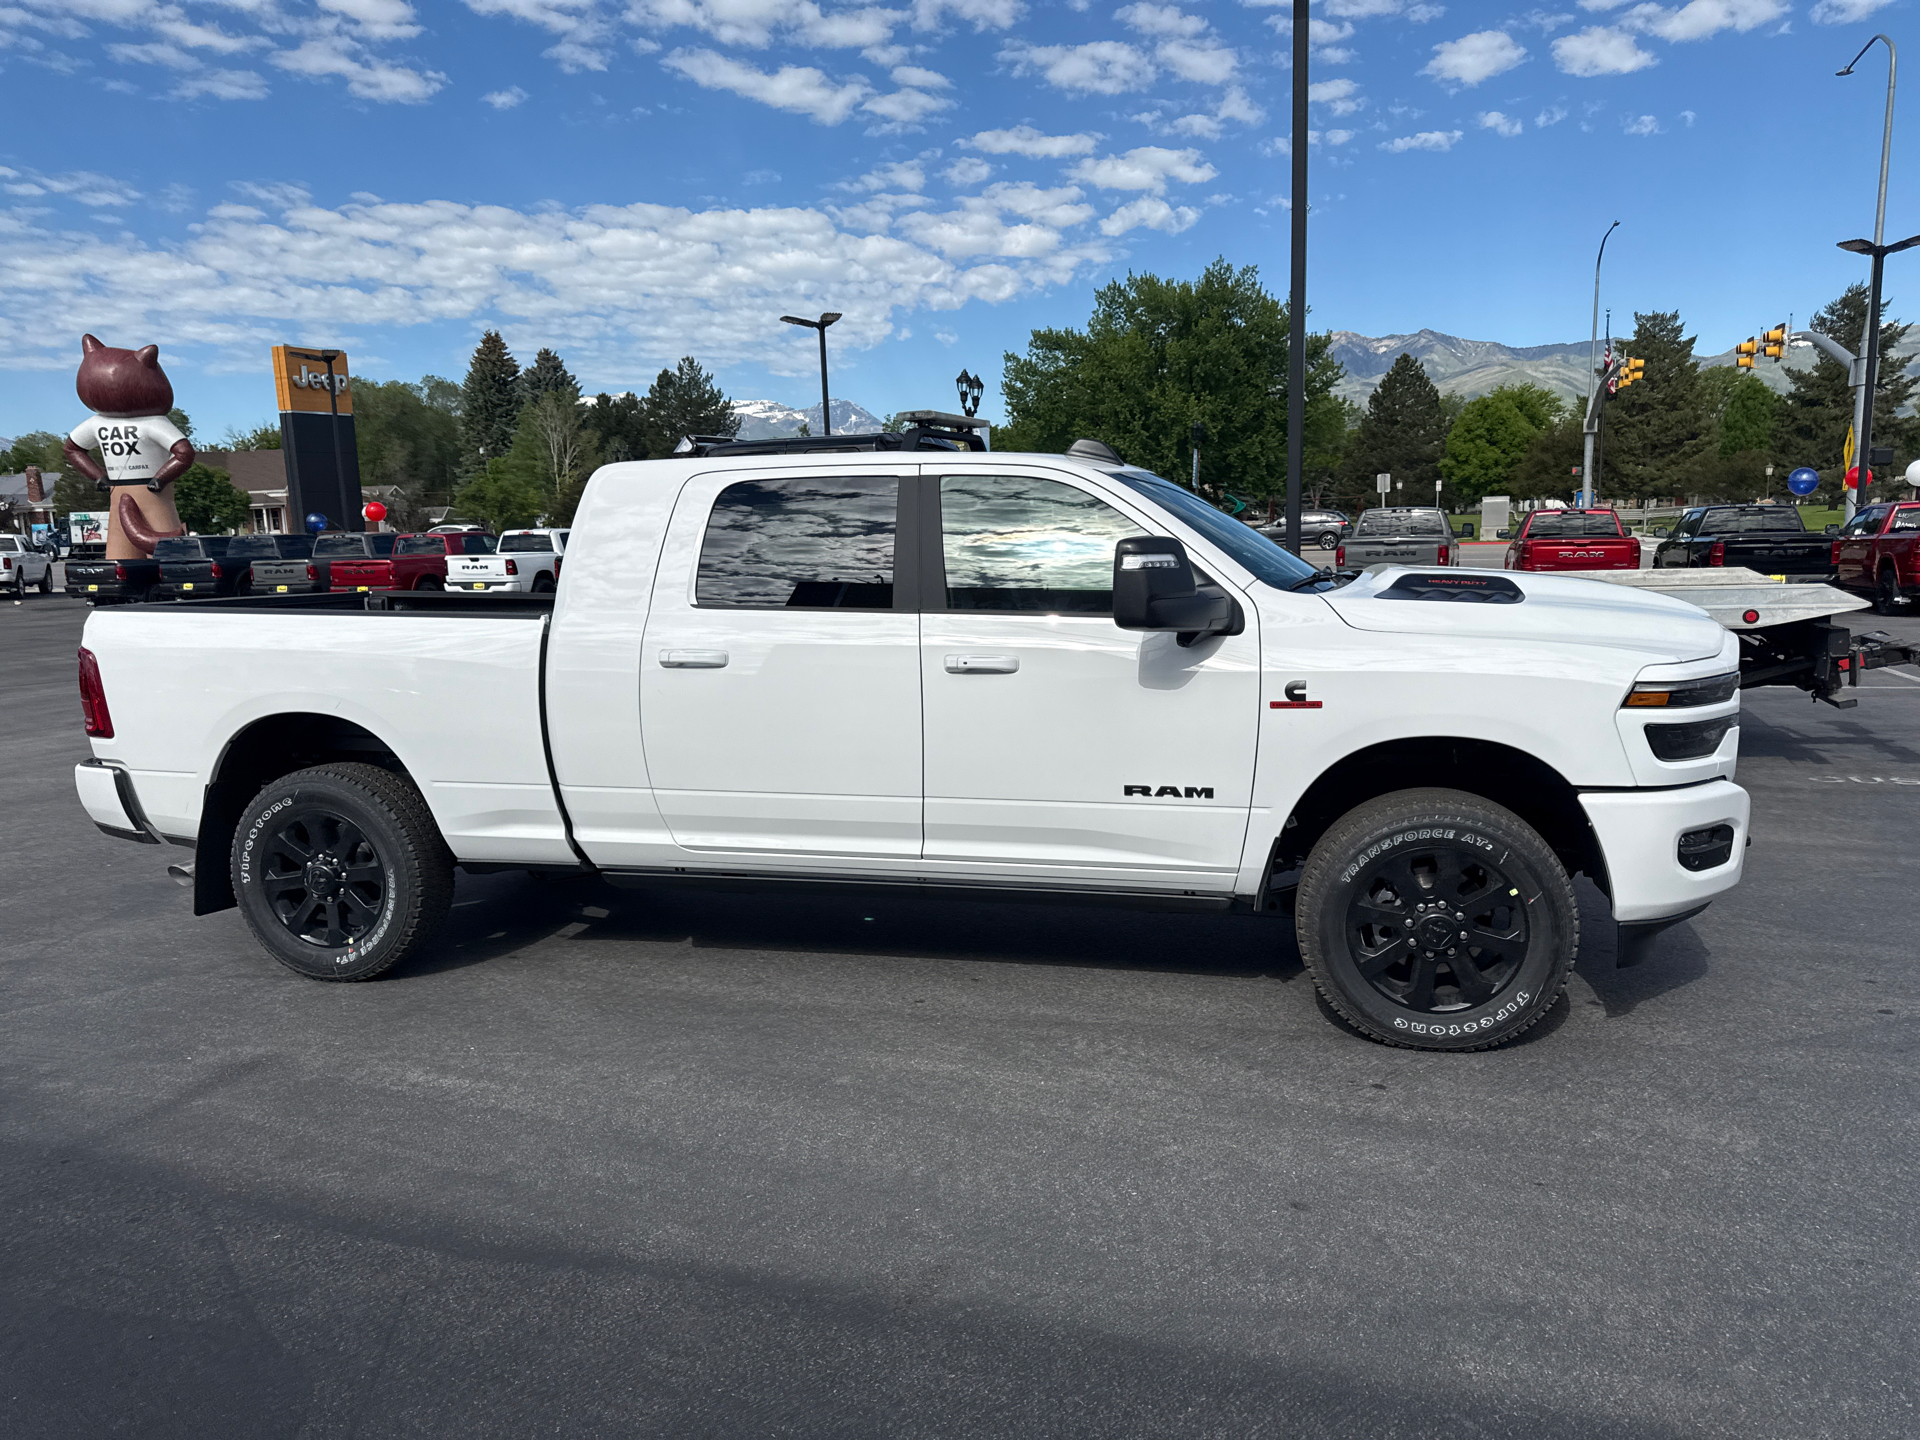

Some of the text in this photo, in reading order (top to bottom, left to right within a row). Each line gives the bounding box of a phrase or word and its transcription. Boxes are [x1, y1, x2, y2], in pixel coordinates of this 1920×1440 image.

[292, 365, 348, 396] Jeep
[98, 425, 139, 441] CAR
[101, 441, 142, 457] FOX
[1123, 784, 1215, 800] RAM
[1341, 828, 1456, 884] TRANSFORCE
[359, 867, 397, 956] TRANSFORCE
